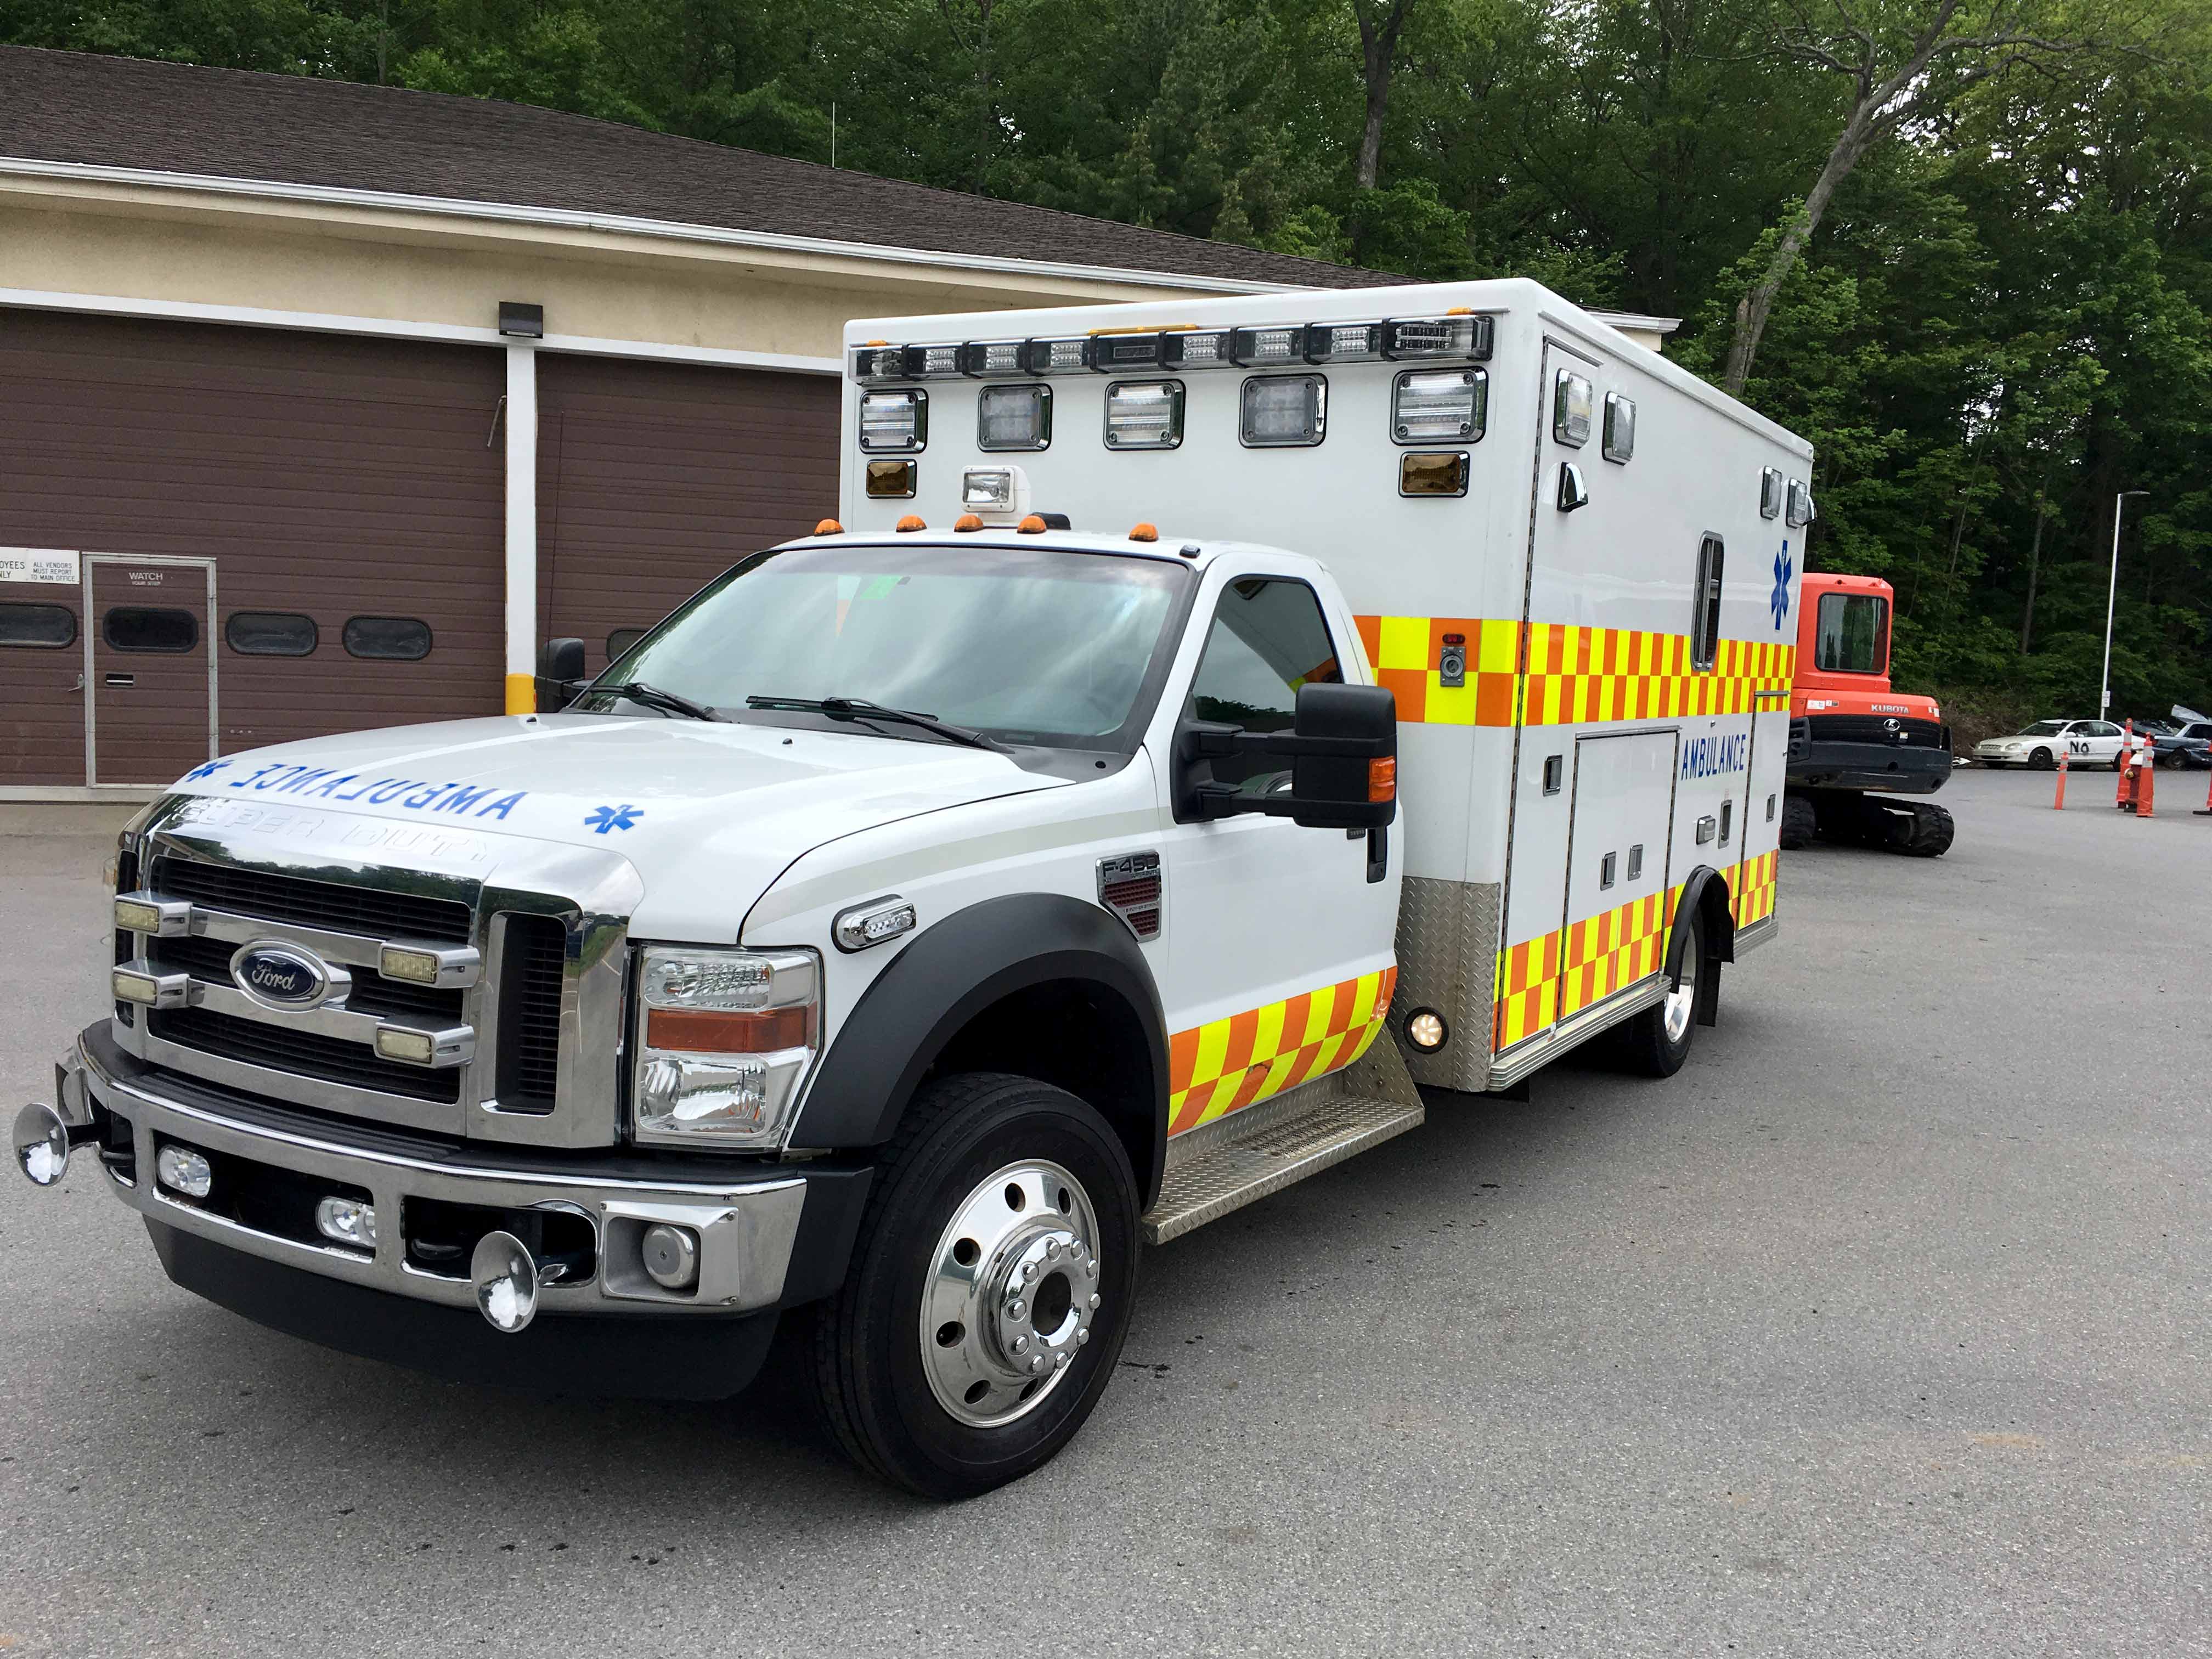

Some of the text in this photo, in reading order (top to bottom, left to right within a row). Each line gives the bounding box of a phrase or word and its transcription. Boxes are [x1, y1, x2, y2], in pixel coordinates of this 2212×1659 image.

[128, 572, 163, 580] WATCH
[1871, 704, 1910, 714] KUBOTA
[1681, 733, 1746, 781] AMBULANCE
[340, 824, 488, 862] DUTY
[252, 958, 296, 991] Ford
